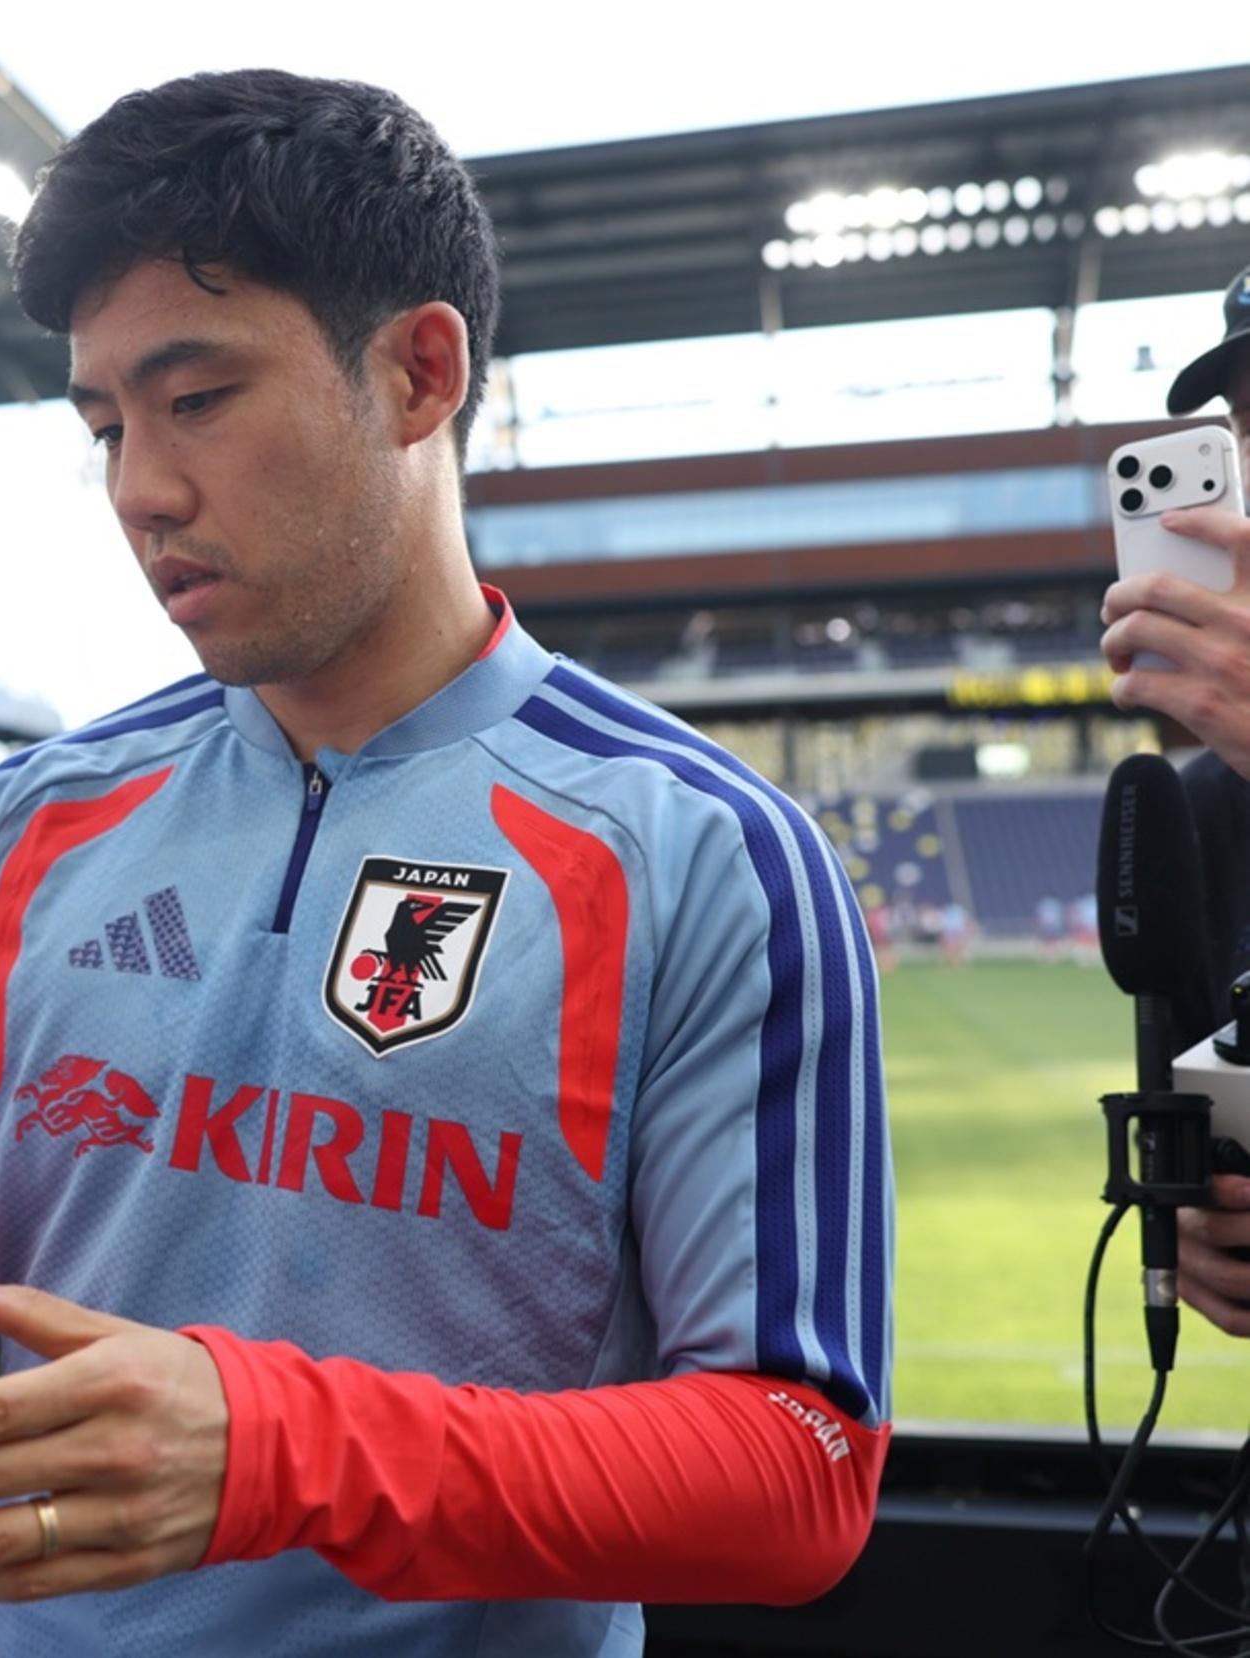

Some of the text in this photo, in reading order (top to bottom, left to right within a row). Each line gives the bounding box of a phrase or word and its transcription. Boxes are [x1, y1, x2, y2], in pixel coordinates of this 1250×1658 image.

[392, 867, 470, 887] JAPAN
[1119, 784, 1137, 898] SENNHEISER
[354, 983, 423, 1021] JFA
[168, 1073, 524, 1231] KIRIN
